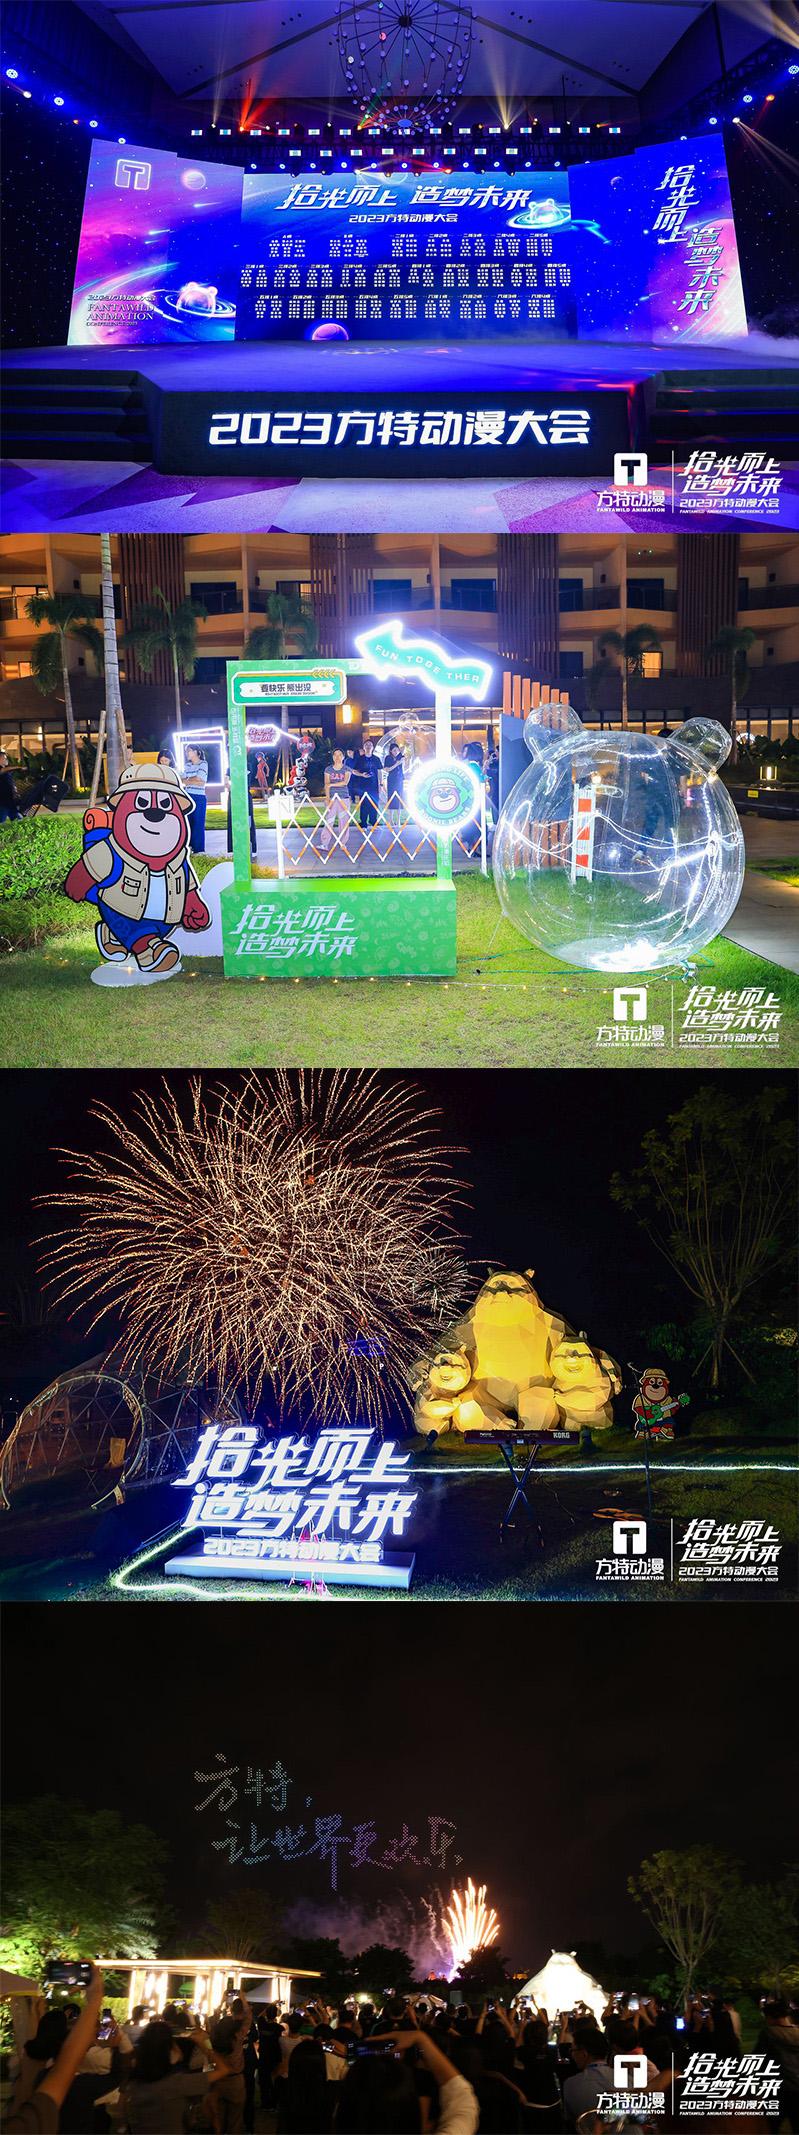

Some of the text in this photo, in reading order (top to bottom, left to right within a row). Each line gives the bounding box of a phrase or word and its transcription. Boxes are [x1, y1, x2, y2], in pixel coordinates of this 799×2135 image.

[275, 184, 533, 210] 拾光而上 造梦未来
[653, 164, 700, 244] 拾光而上
[349, 213, 458, 223] 2023方特动漫大会
[677, 227, 724, 315] 造梦未来
[87, 313, 153, 321] ANIMATION
[88, 304, 154, 312] FANTAWILD
[208, 410, 590, 445] 2023方特动漫大会
[375, 644, 399, 661] FUN
[229, 904, 355, 936] 拾光而上
[235, 932, 358, 959] 造梦未来
[171, 1425, 410, 1493] 拾光而上
[181, 1480, 418, 1542] 造梦未来
[203, 1537, 384, 1562] 2023方特动漫大会
[211, 1814, 463, 1890] 让世界更欢乐
